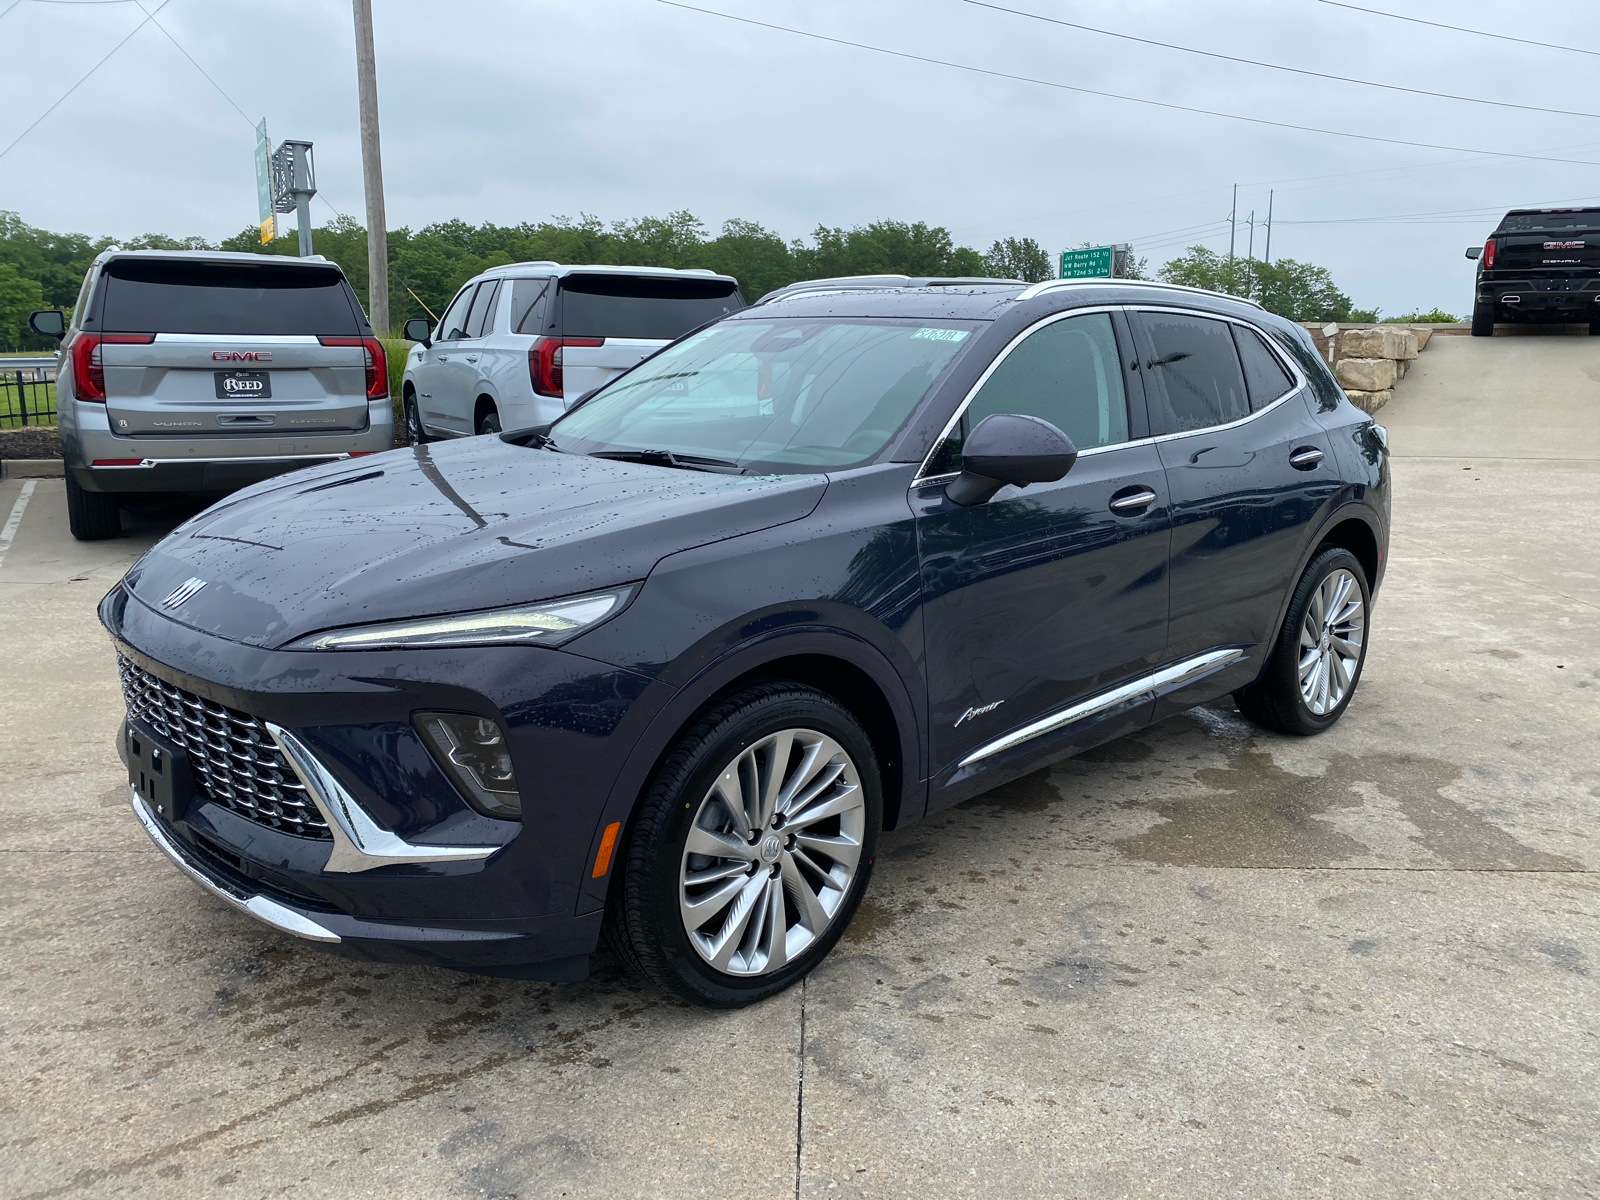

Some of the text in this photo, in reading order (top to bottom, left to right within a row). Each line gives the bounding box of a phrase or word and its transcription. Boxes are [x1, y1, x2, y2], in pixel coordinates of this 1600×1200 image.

[1543, 240, 1585, 250] GMC
[212, 350, 272, 362] GMC
[223, 377, 263, 393] REED
[953, 700, 1005, 728] Avenir
